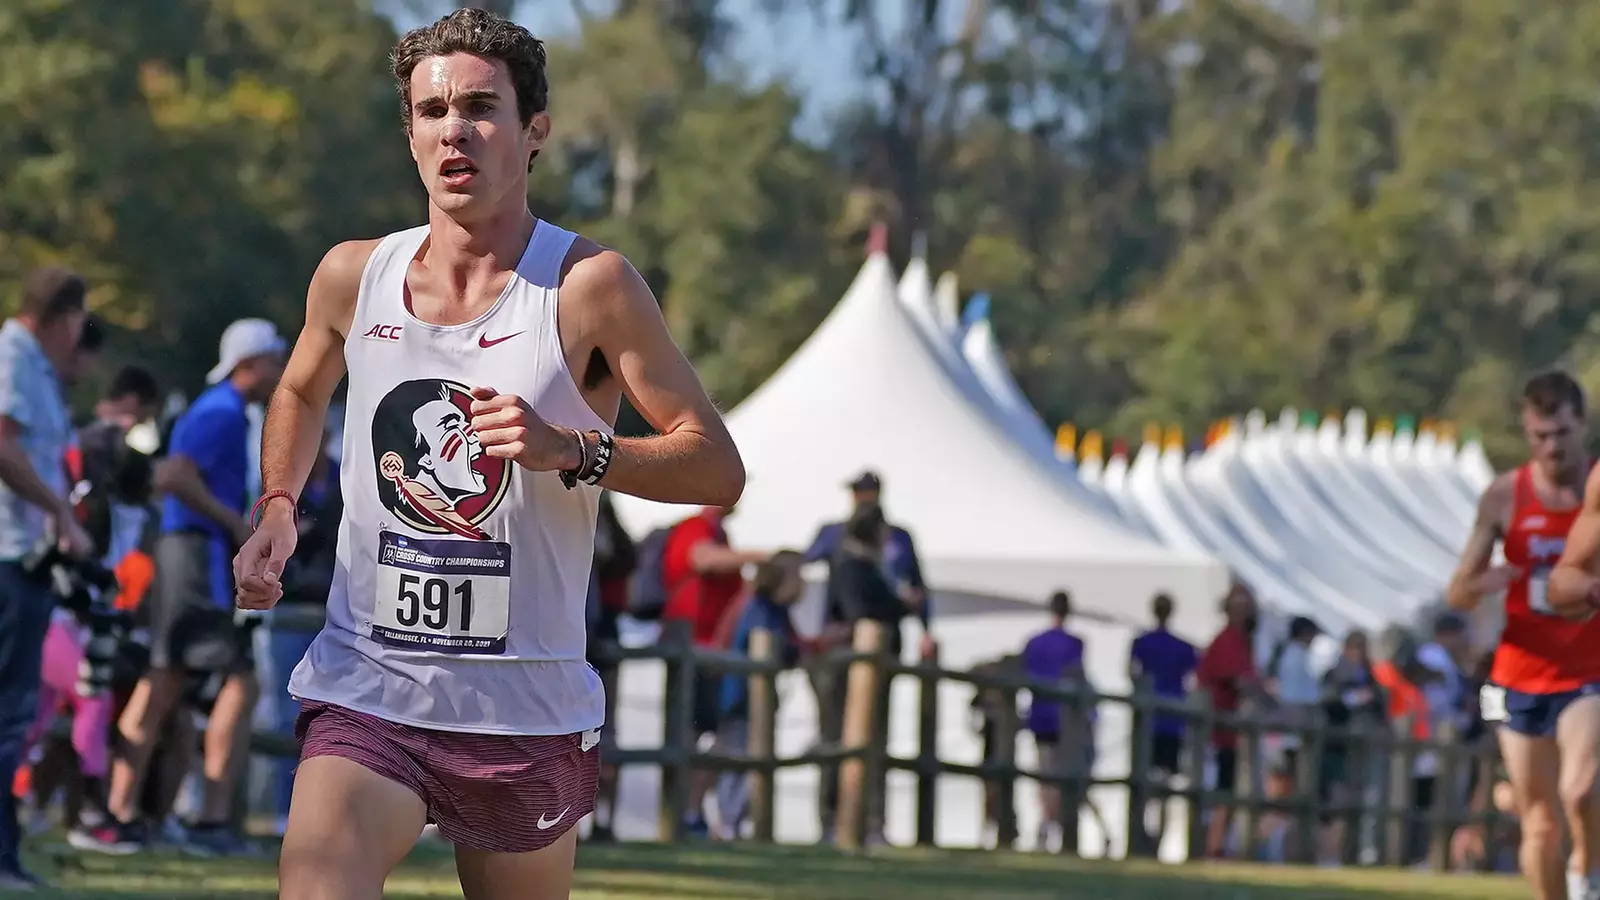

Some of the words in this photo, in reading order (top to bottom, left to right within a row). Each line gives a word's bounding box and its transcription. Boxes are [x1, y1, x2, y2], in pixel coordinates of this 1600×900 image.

[363, 324, 403, 340] ACC
[395, 550, 415, 562] CROSS
[416, 554, 445, 566] COUNTRY
[445, 557, 505, 568] CHAMPIONSHIPS
[396, 573, 473, 631] 591
[432, 638, 463, 647] NOVEMBER
